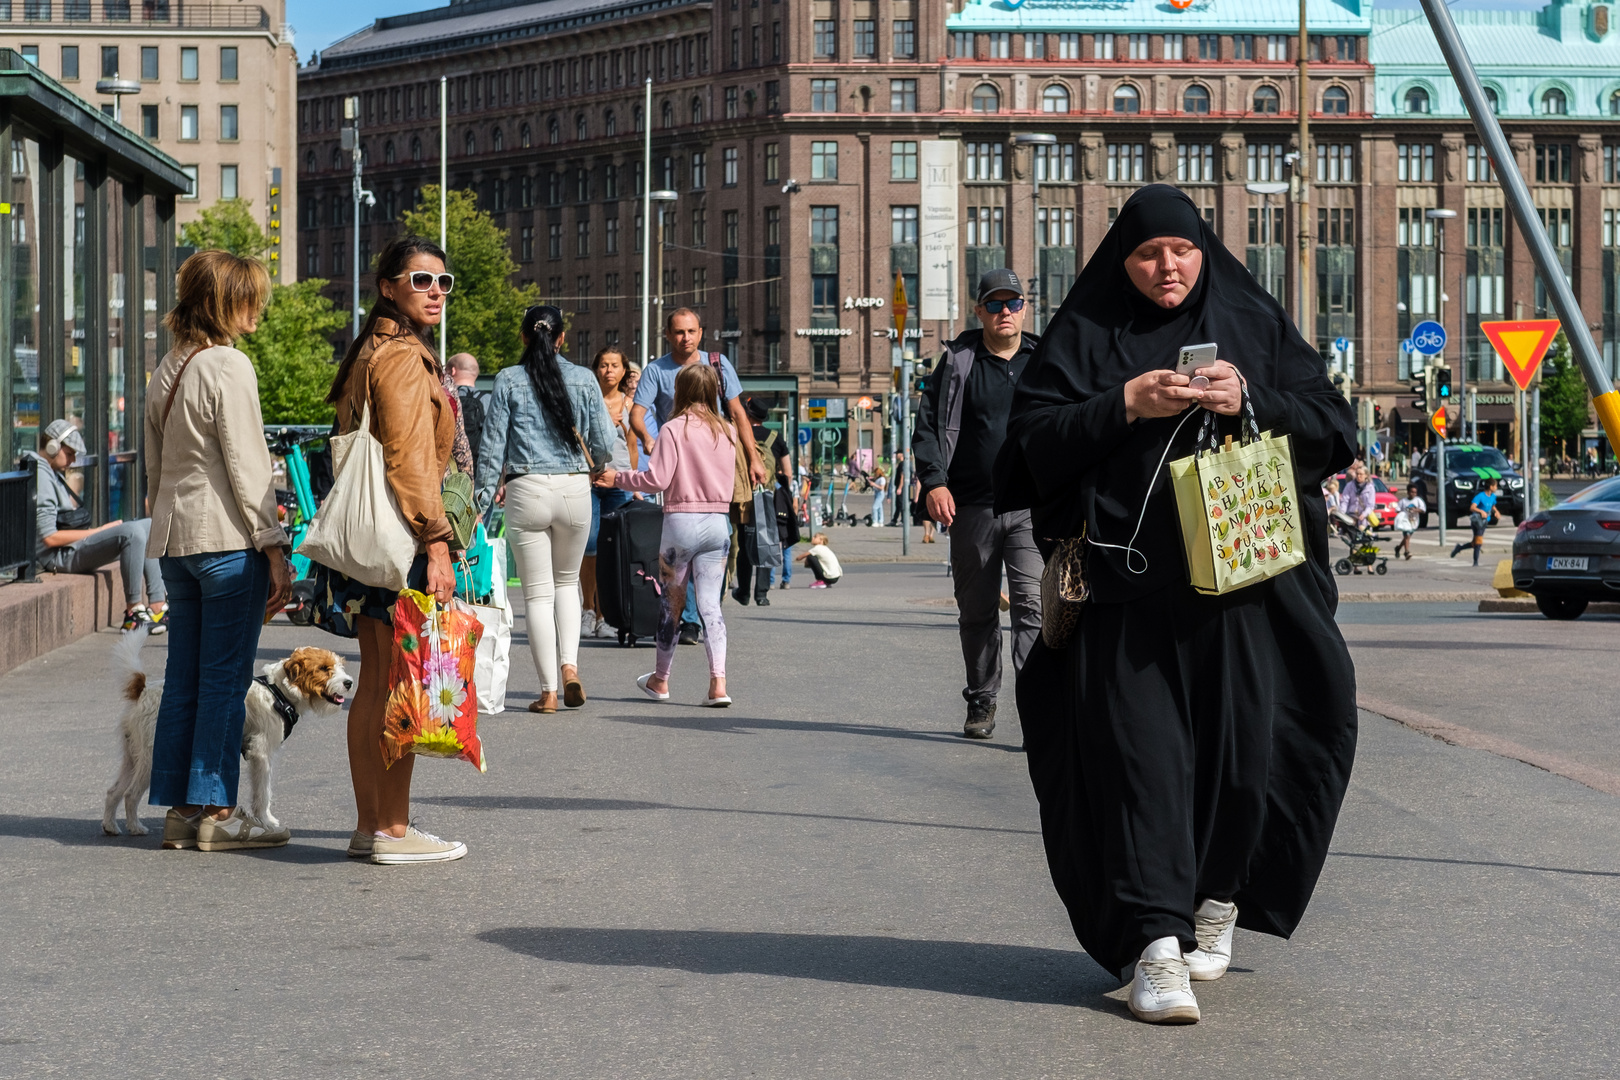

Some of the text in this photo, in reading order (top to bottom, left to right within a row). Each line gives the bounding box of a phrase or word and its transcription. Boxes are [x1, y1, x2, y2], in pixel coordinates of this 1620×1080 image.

[932, 168, 947, 182] M
[855, 297, 885, 307] ASPO
[797, 328, 852, 336] WUNDERDOG
[1552, 558, 1585, 569] CNX-841
